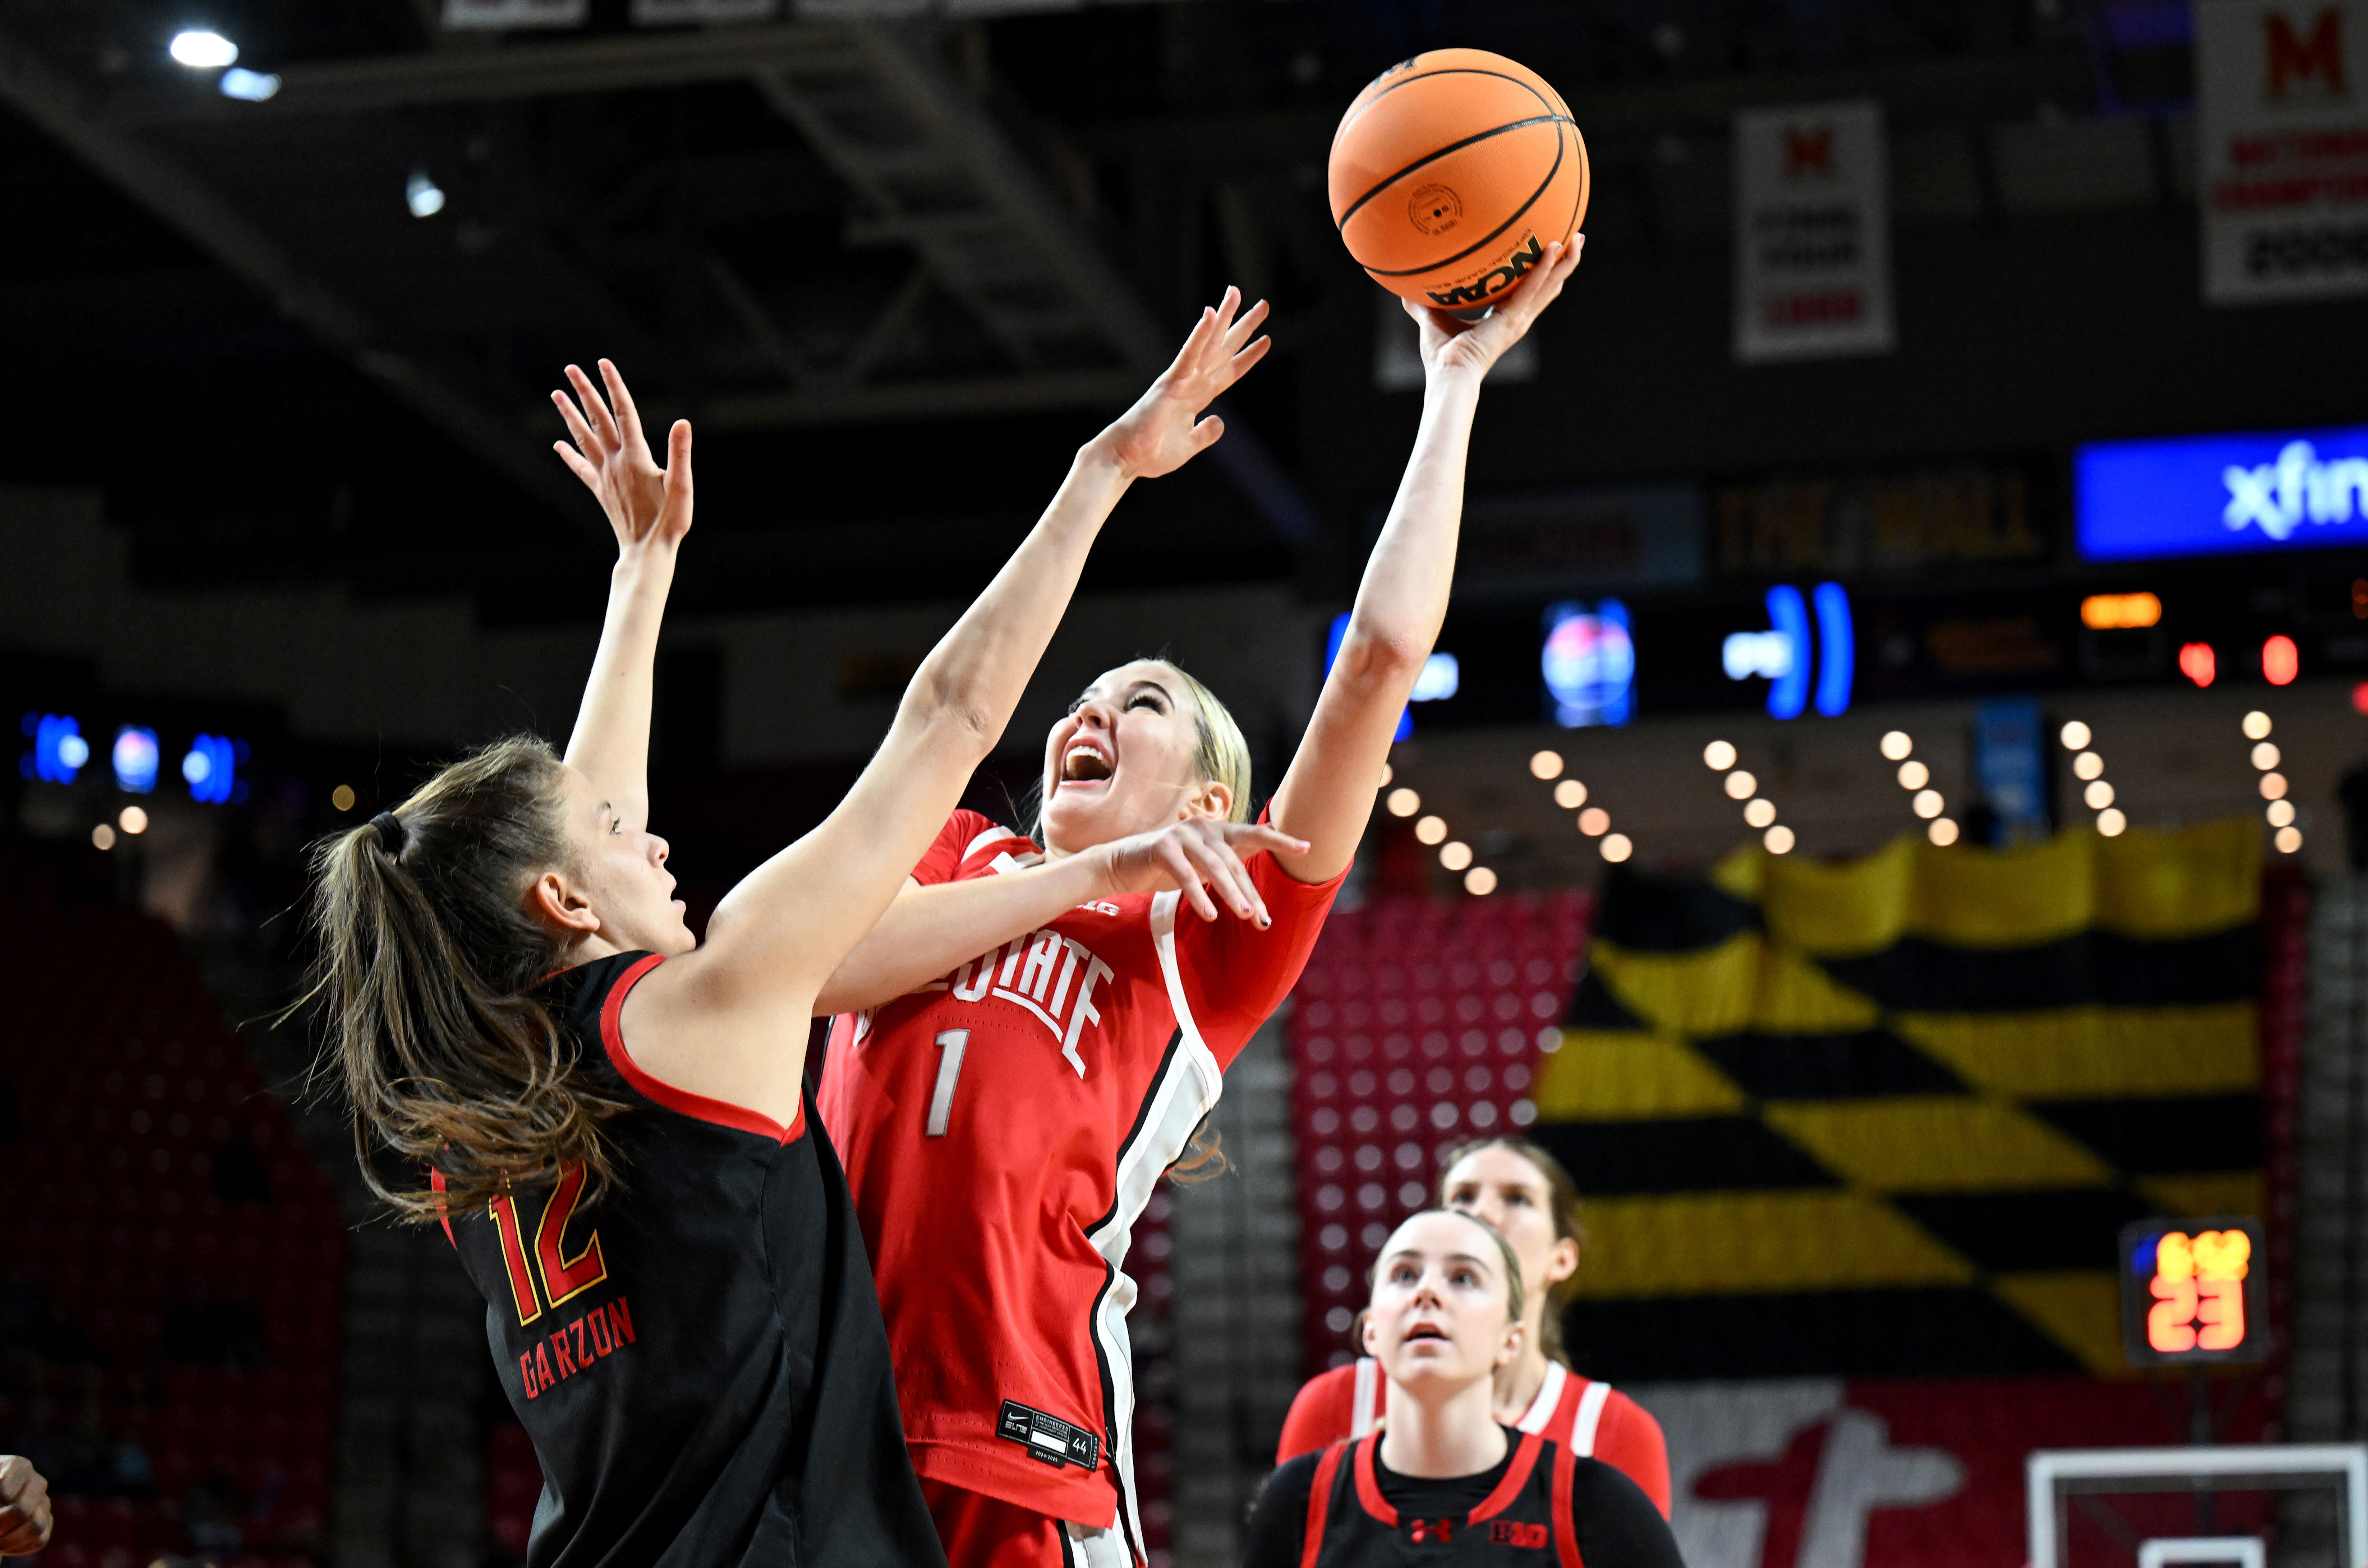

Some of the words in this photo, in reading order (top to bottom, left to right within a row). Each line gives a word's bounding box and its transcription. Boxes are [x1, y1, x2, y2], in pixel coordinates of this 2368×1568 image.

[1424, 233, 1543, 306] NCAA
[925, 1028, 971, 1137] 1
[488, 1157, 608, 1327] 12
[520, 1296, 637, 1399] GARZON
[1036, 1415, 1069, 1432] ENGINEERED
[1072, 1437, 1087, 1455] 44
